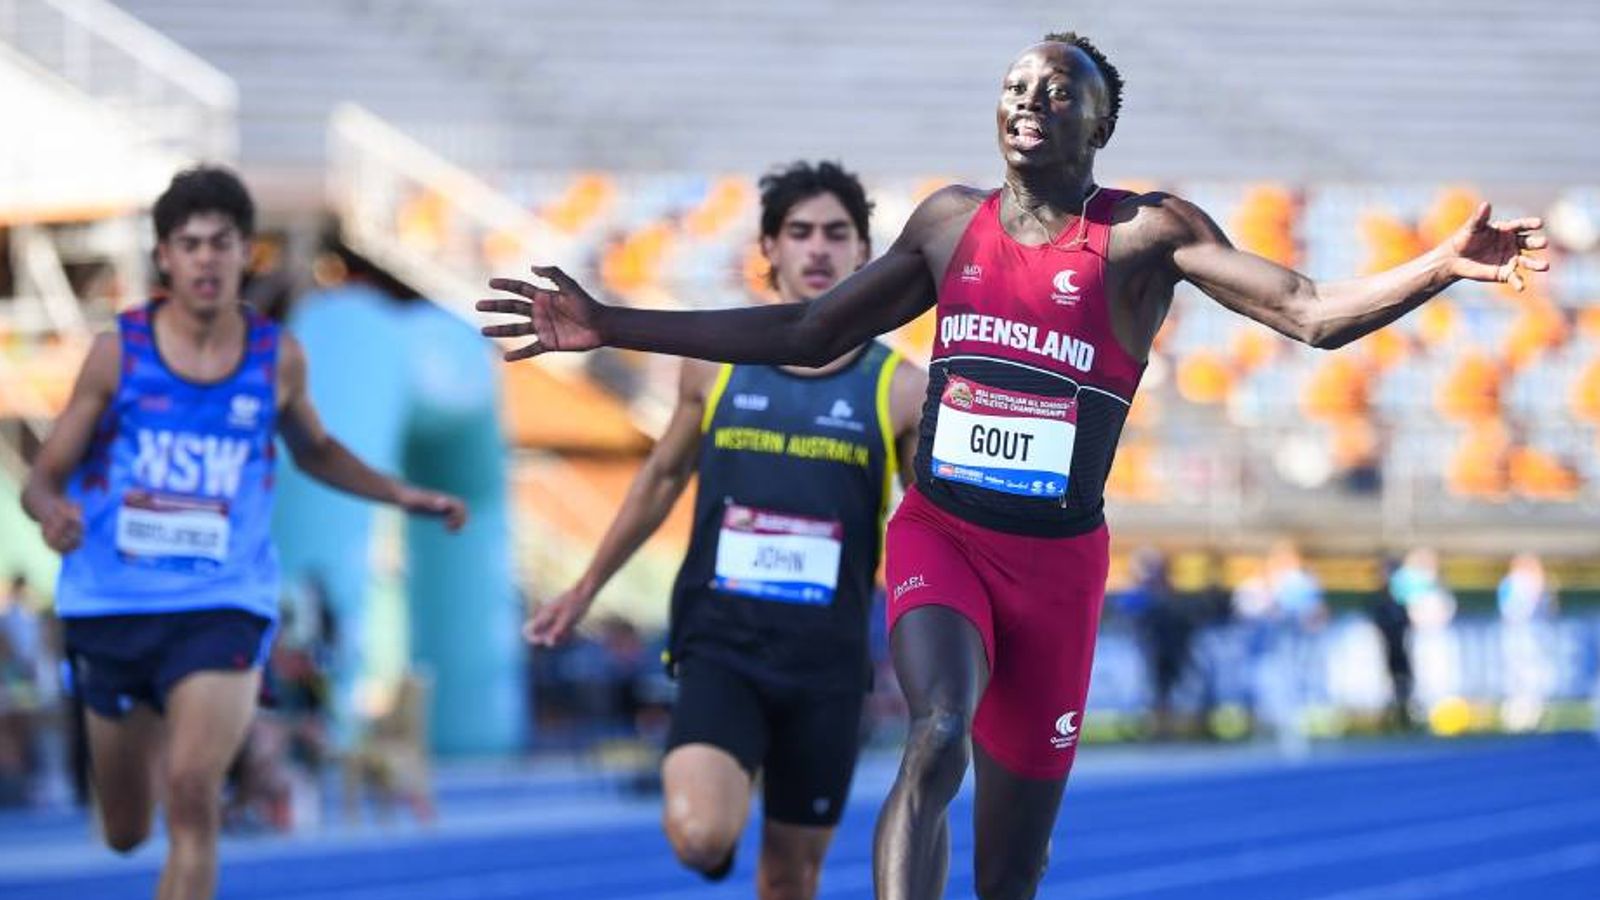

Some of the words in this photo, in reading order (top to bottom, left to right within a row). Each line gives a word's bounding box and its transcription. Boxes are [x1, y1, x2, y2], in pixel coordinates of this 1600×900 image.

[941, 313, 1095, 372] QUEENSLAND
[133, 430, 249, 497] NSW
[716, 427, 784, 453] WESTERN
[970, 424, 1034, 461] GOUT
